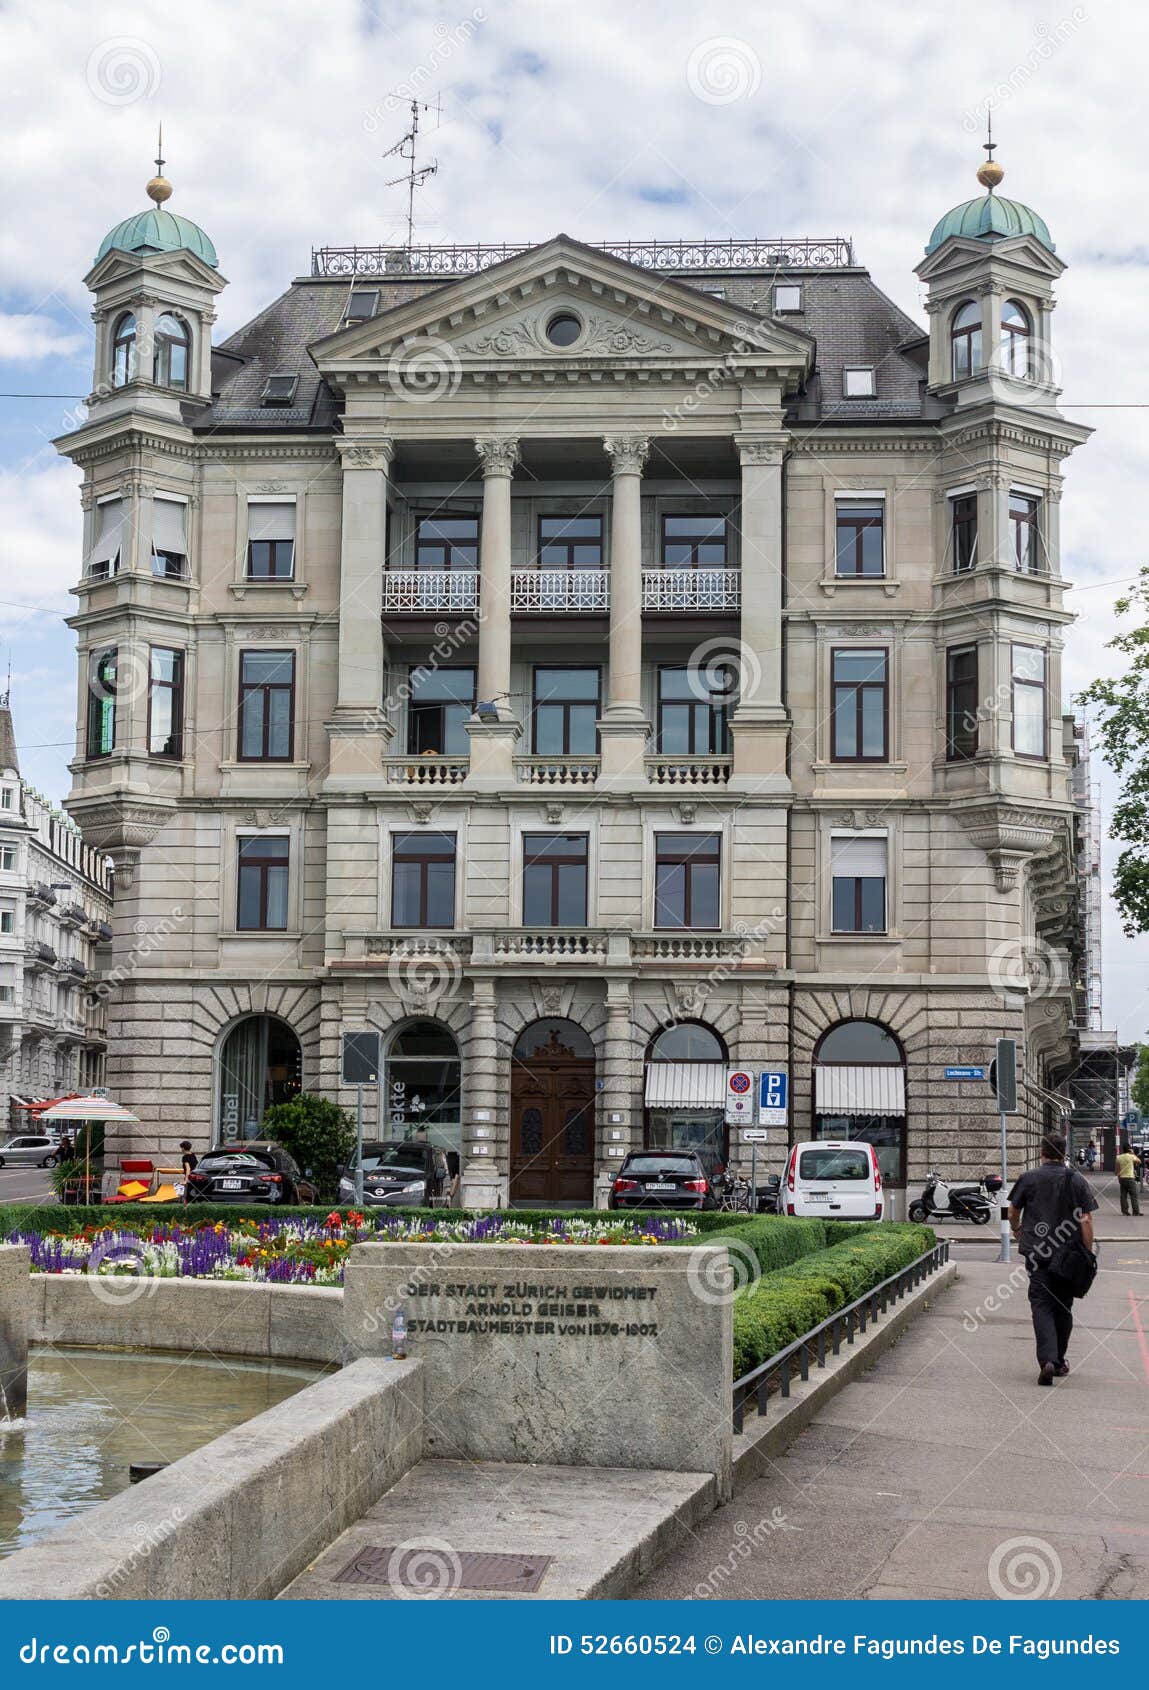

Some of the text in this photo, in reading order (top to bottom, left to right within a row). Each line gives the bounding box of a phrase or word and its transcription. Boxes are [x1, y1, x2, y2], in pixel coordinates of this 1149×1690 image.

[768, 1075, 781, 1092] P
[406, 1282, 658, 1300] DER STADT ZÜRICH GEWIDMET
[465, 1303, 600, 1317] ARNOLD GEISER
[406, 1319, 555, 1335] STADTBAUMEISTER
